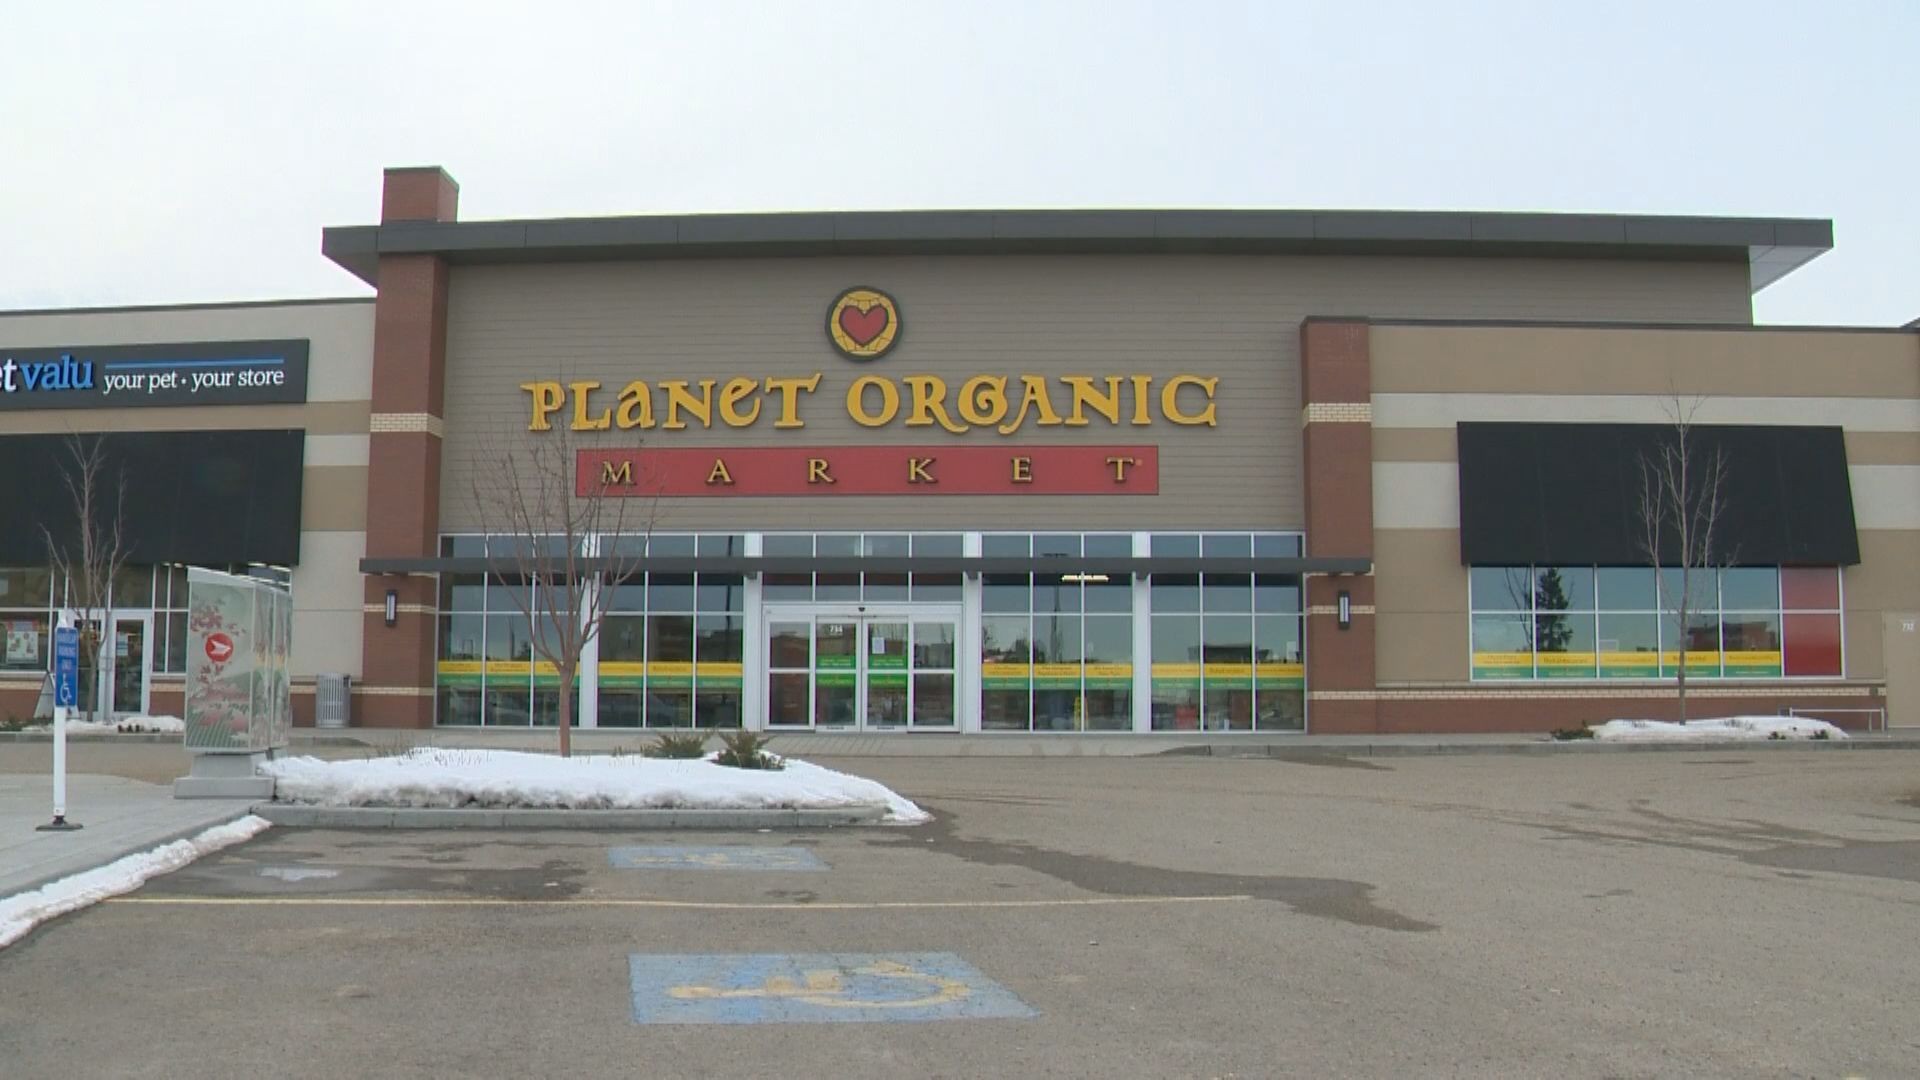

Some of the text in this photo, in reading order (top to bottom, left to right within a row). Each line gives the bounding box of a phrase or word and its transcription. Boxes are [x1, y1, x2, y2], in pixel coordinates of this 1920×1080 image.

[19, 353, 93, 391] valu
[103, 368, 285, 395] your pet your store
[846, 374, 1220, 435] ORGANIC
